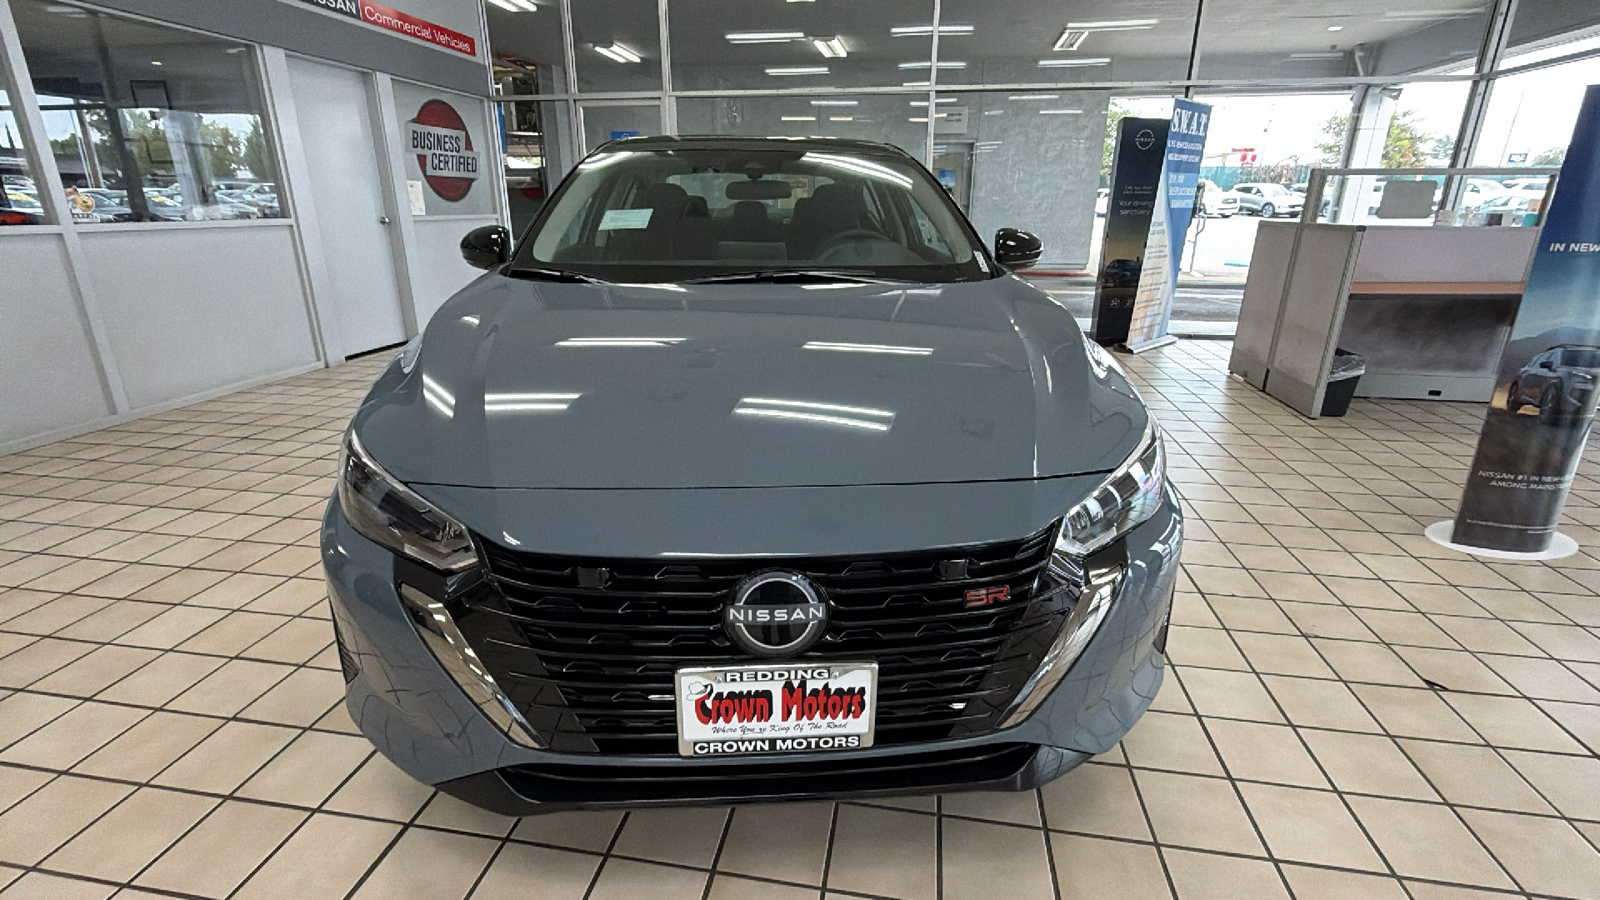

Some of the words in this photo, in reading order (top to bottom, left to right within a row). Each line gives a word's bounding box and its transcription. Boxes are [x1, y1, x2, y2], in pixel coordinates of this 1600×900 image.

[364, 6, 432, 39] Commercial
[433, 29, 471, 52] Vehicles
[412, 130, 460, 153] BUSINESS
[431, 152, 477, 173] CERTIFIED
[1549, 242, 1566, 252] IN
[1478, 471, 1515, 480] NISSAN
[1529, 475, 1540, 483] IN
[1489, 480, 1528, 489] AMONG
[965, 586, 1010, 607] SR
[729, 606, 823, 621] NISSAN
[726, 669, 828, 682] REDDING
[695, 684, 773, 725] Crown
[781, 680, 866, 722] Motors
[712, 726, 737, 734] Where
[770, 724, 790, 733] King
[793, 723, 805, 732] Of
[808, 722, 823, 730] The
[825, 721, 849, 730] Road
[695, 739, 769, 754] CROWN
[776, 736, 859, 750] MOTORS
